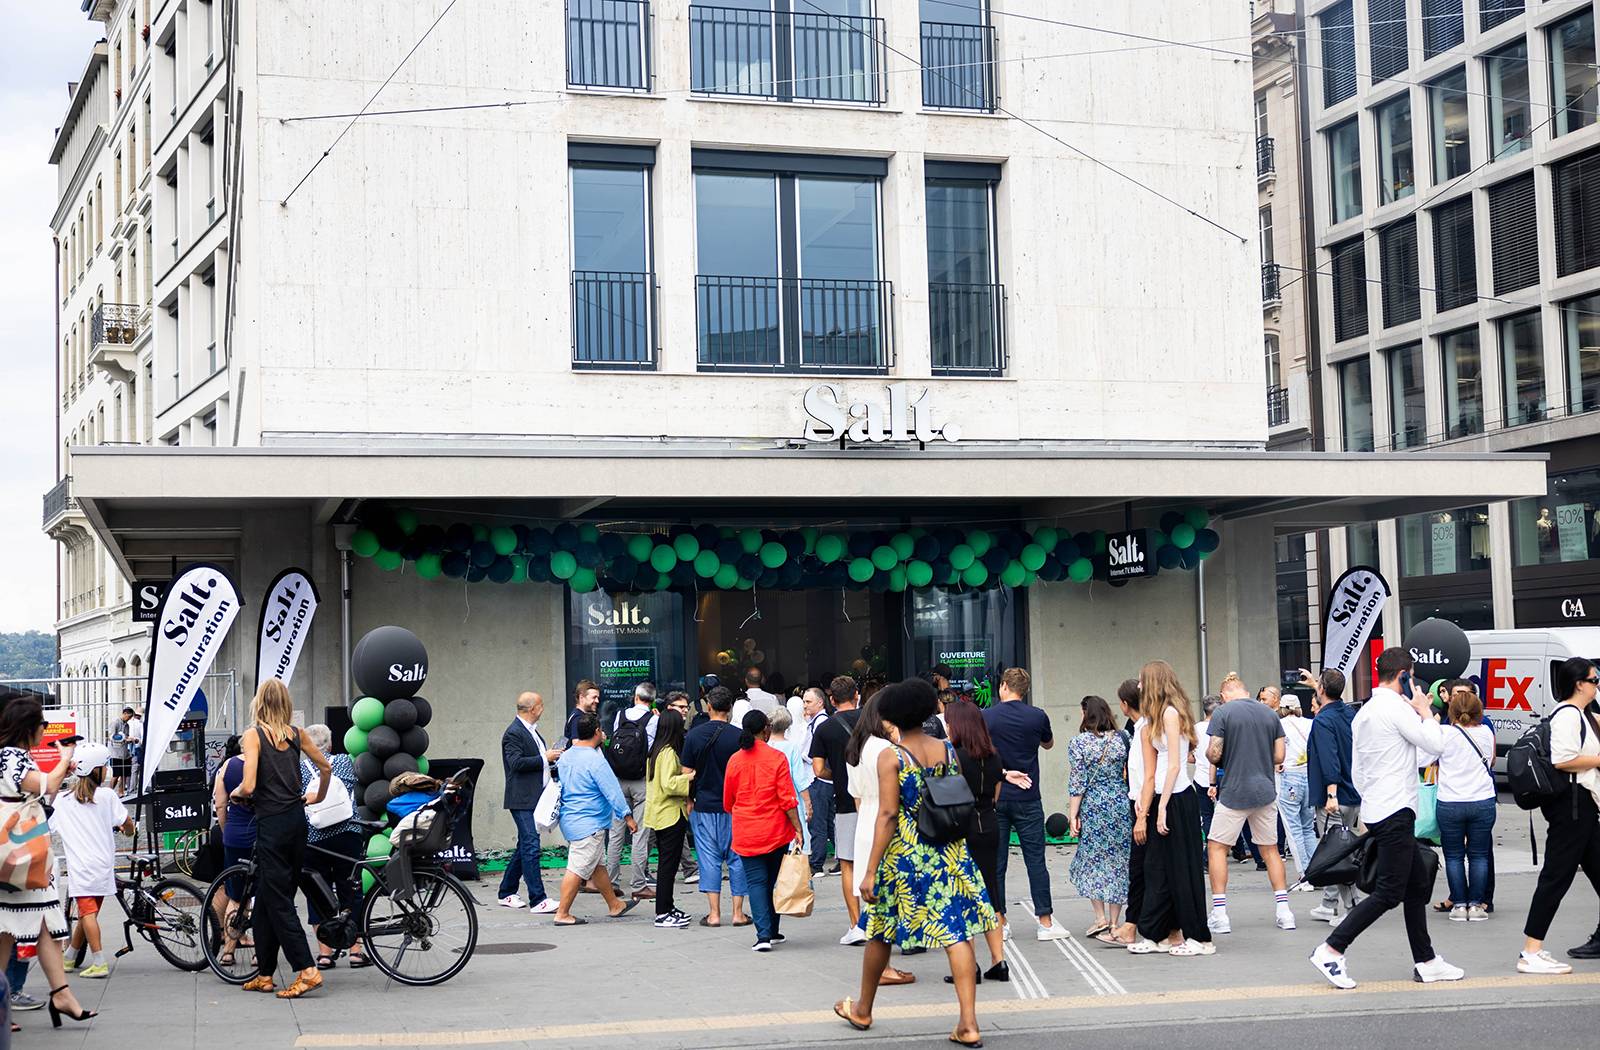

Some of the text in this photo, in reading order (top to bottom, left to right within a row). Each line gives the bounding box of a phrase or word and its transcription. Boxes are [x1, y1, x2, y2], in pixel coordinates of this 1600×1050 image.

[803, 382, 961, 442] Salt.
[1558, 506, 1583, 525] 50%
[1433, 525, 1453, 541] 50%
[1109, 534, 1144, 566] Salt.
[163, 578, 217, 647] Salt.
[265, 581, 301, 643] Salt.
[588, 601, 651, 626] Salt.
[1331, 576, 1371, 627] Salt.
[1561, 598, 1586, 617] C&A
[275, 598, 310, 680] uguration
[1337, 591, 1381, 671] nauguration
[163, 600, 231, 711] Inauguration
[600, 659, 650, 668] OUVERTURE
[940, 651, 986, 659] OUVERTURE
[1409, 647, 1450, 664] Salt.
[1490, 717, 1522, 732] xpress
[165, 805, 198, 819] Salt.
